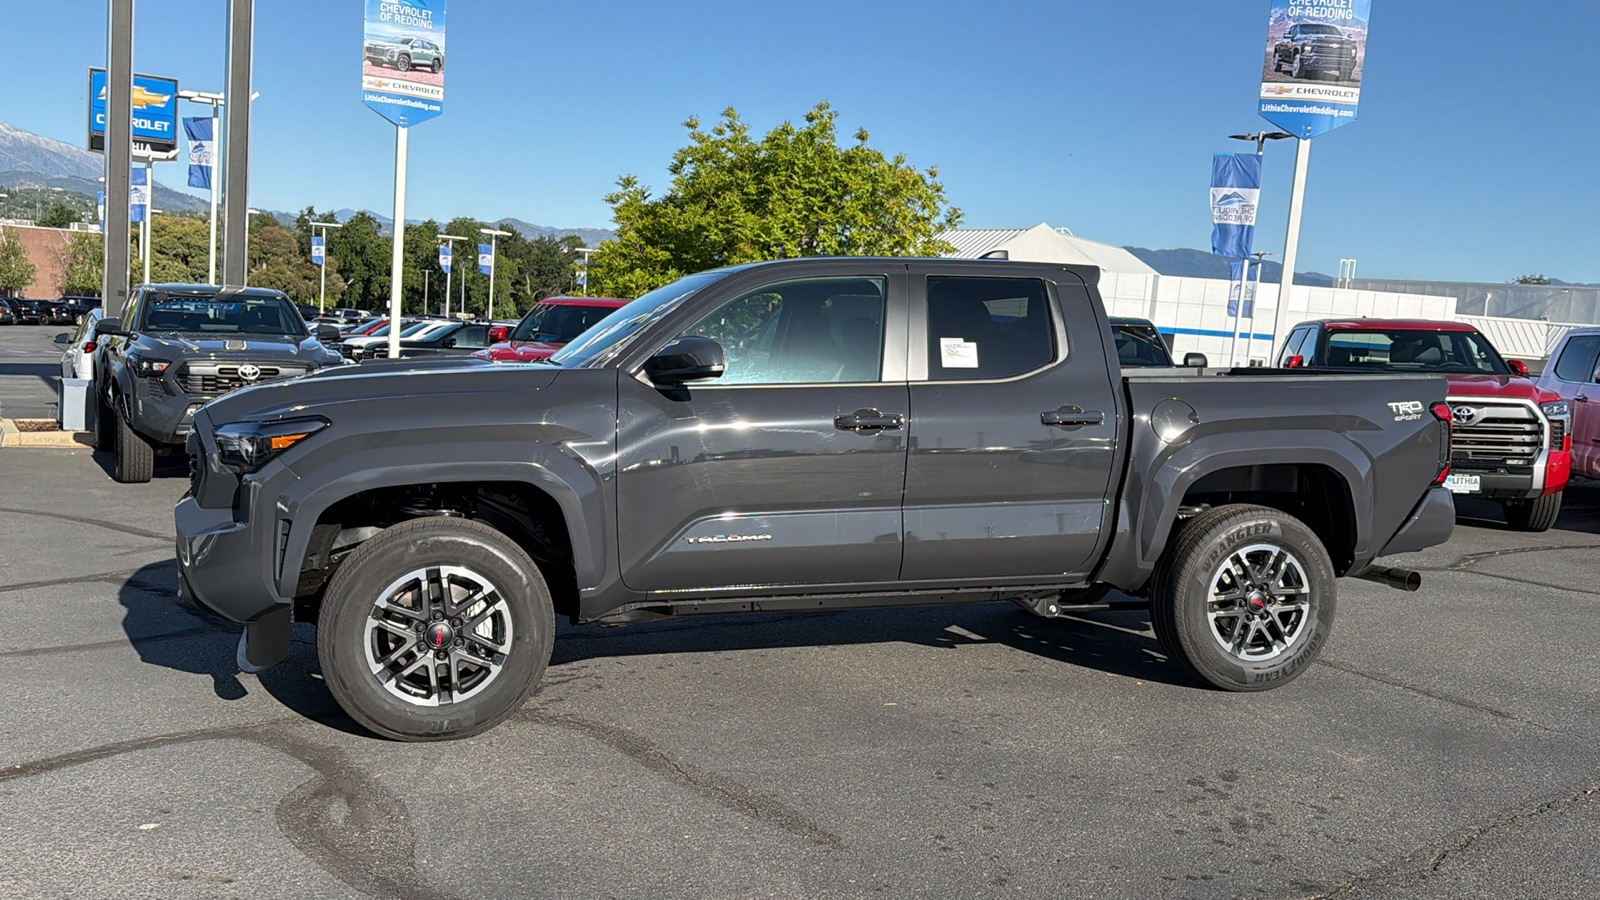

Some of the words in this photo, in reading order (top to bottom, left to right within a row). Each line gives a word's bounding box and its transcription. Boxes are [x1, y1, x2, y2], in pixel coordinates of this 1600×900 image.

[380, 2, 433, 19] CHEVROLET
[1288, 6, 1303, 17] OF
[1305, 6, 1353, 20] REDDING
[380, 12, 393, 21] OF
[394, 14, 433, 29] REDDING
[392, 82, 440, 95] CHEVROLET
[1296, 87, 1355, 98] CHEVROLET
[364, 93, 441, 111] LithiaChevroletRedding.com
[1261, 103, 1354, 117] LithiaChevroletRedding.com
[96, 113, 170, 131] CROLET
[1387, 400, 1424, 415] TRD
[1452, 477, 1479, 485] LITHIA
[682, 533, 772, 544] TACOMA
[1201, 523, 1273, 574] WRANGLER
